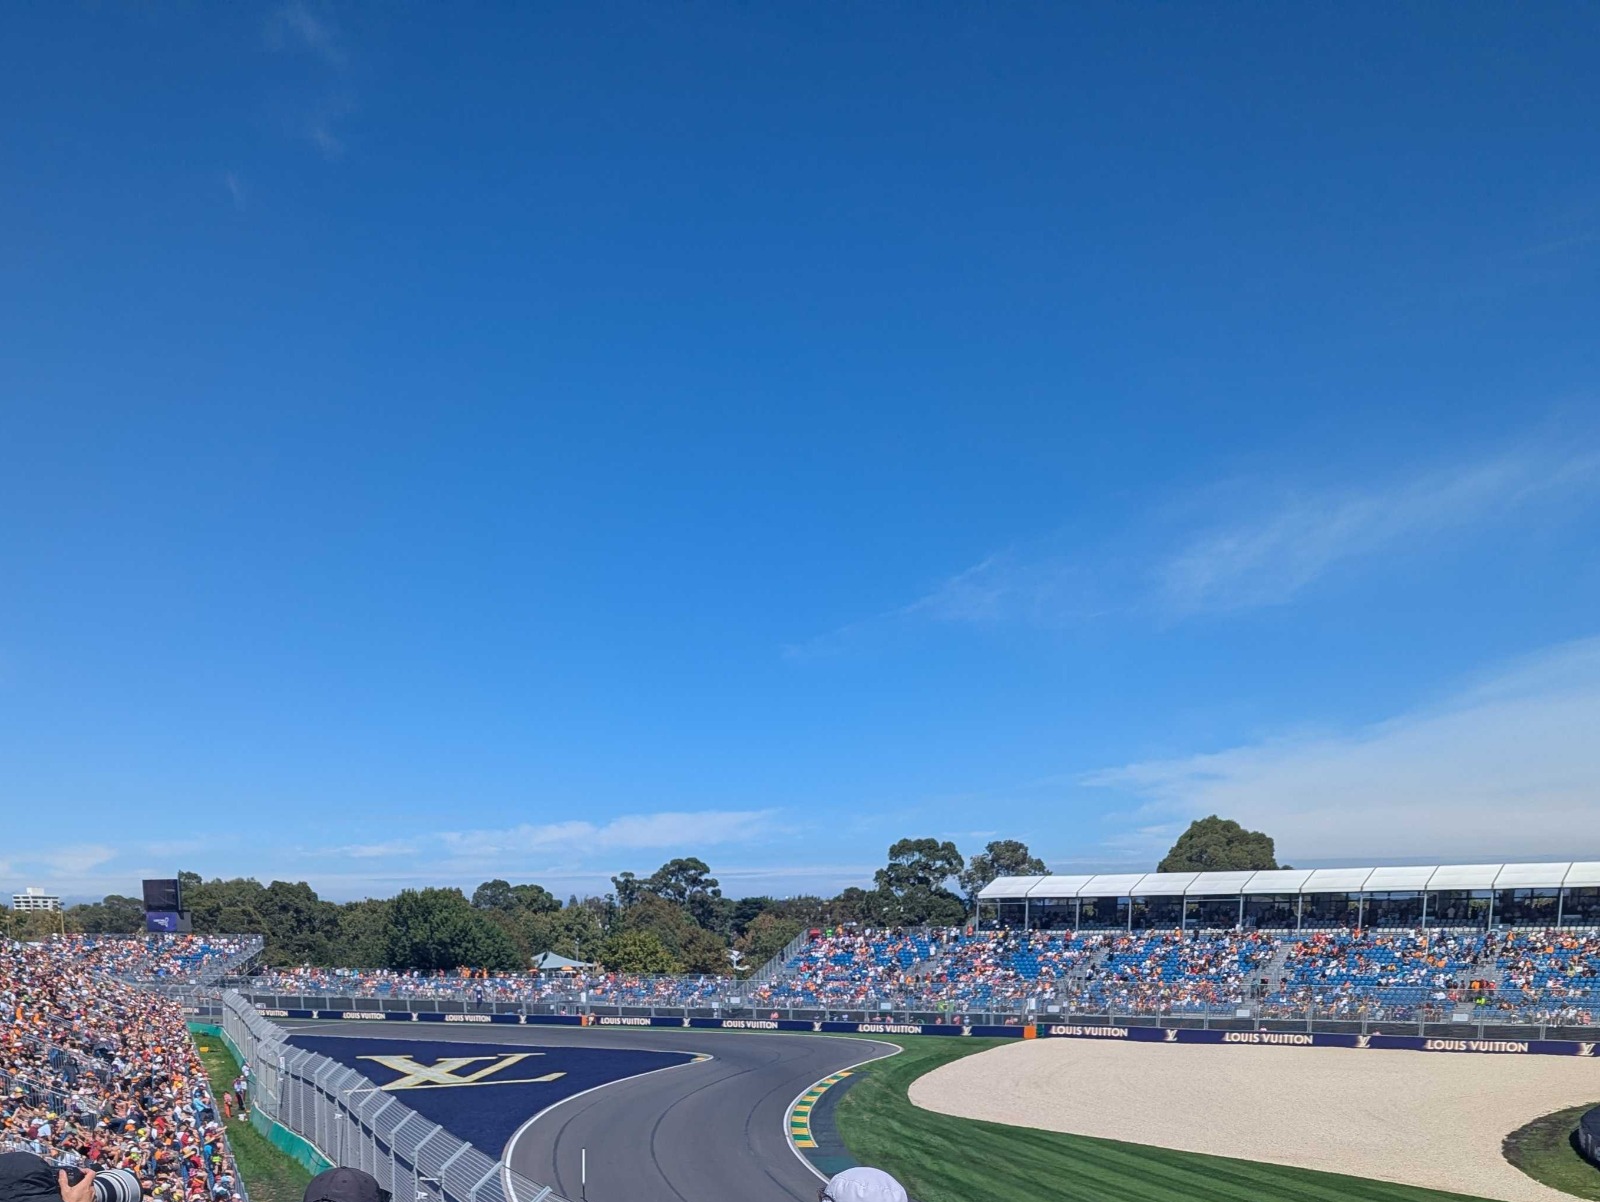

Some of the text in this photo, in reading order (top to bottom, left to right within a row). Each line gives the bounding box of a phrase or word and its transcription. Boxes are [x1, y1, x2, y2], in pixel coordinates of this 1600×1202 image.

[445, 1014, 491, 1023] LOUIS VUITTON
[600, 1017, 651, 1026] LOUIS VUITTON
[722, 1020, 778, 1030] LOUIS VUITTON
[858, 1024, 922, 1034] LOUIS VUITTON
[1050, 1026, 1128, 1037] LOUIS VUITTON
[1224, 1032, 1313, 1045] LOUIS VUITTON
[1426, 1039, 1528, 1053] LOUIS VUITTON
